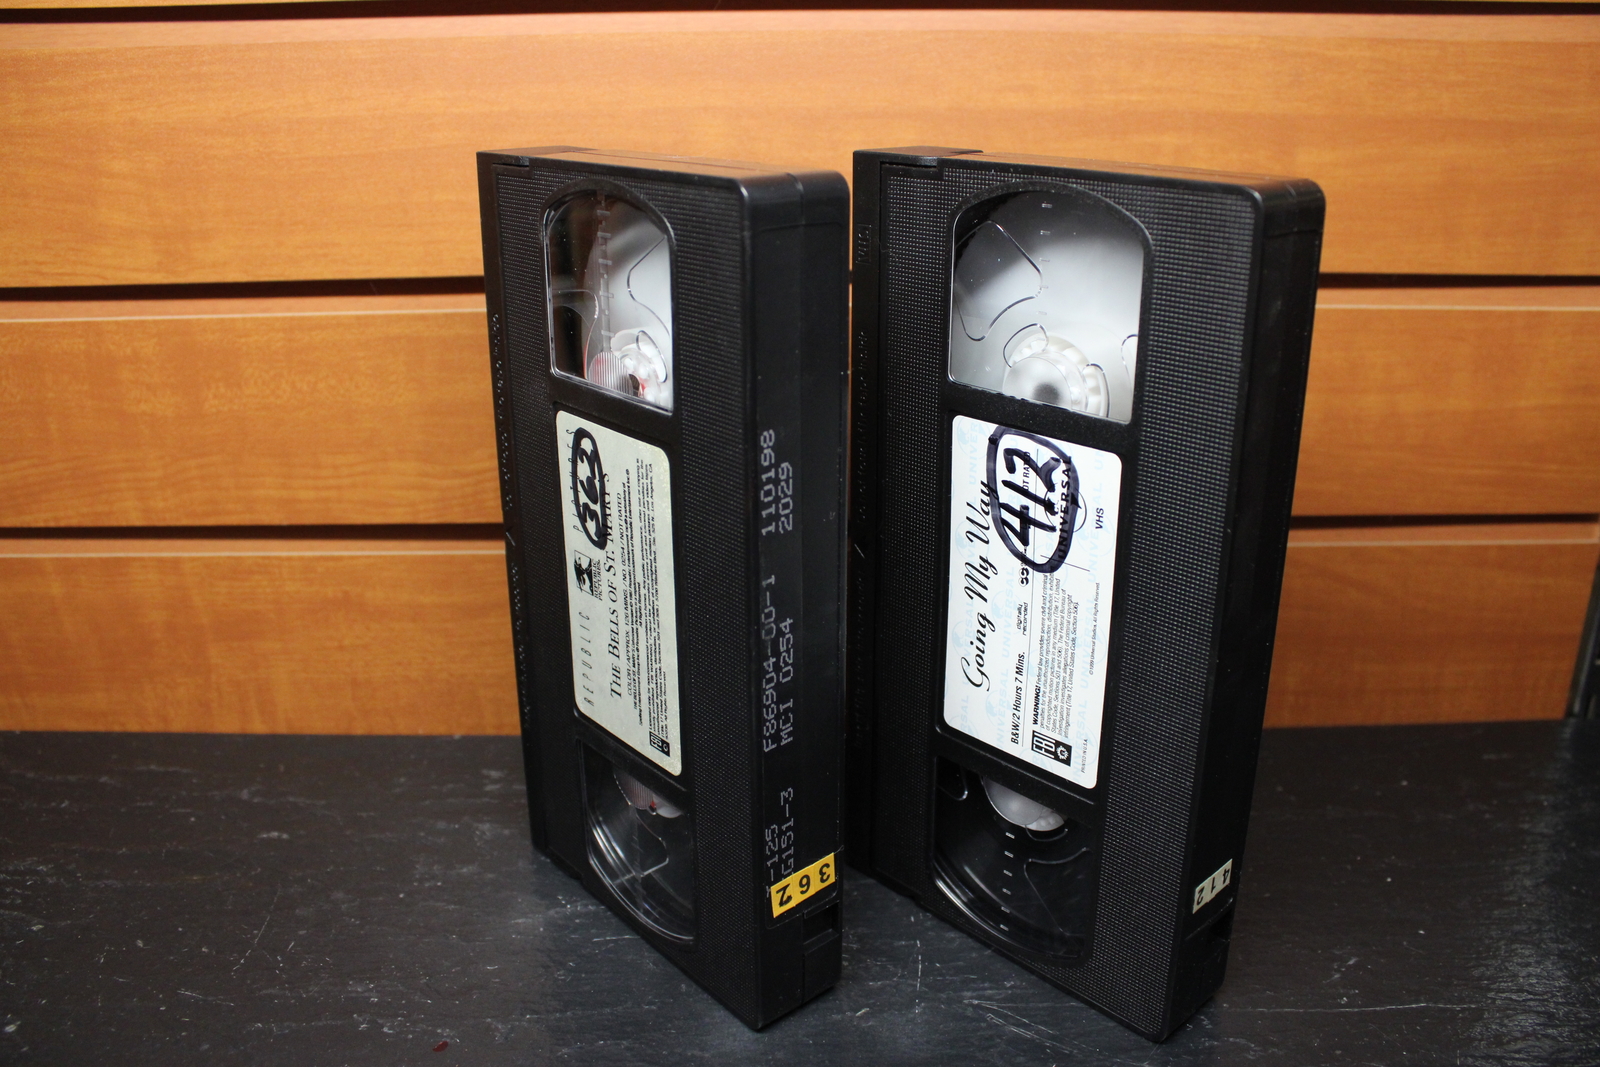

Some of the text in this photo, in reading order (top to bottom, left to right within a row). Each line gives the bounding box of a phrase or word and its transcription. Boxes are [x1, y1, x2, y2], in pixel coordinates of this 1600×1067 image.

[760, 429, 776, 536] 110198
[1058, 456, 1072, 559] UNIVERSAL
[1095, 507, 1104, 529] VHS
[602, 545, 616, 576] ST.
[607, 579, 617, 602] OF
[961, 481, 999, 691] Going My Way
[608, 607, 619, 659] BELLS
[578, 611, 594, 706] REPUBLIC
[761, 574, 777, 752] F86904-00-1
[778, 462, 794, 882] G151-3 MCI 0254 2029
[1015, 652, 1024, 676] Mins.
[610, 663, 621, 697] THE
[1012, 685, 1022, 712] Hours
[1032, 685, 1040, 724] WARNING!
[1010, 712, 1020, 744] B&W/2
[1033, 732, 1055, 758] FBI
[775, 862, 832, 910] 362
[1196, 868, 1231, 906] 412
